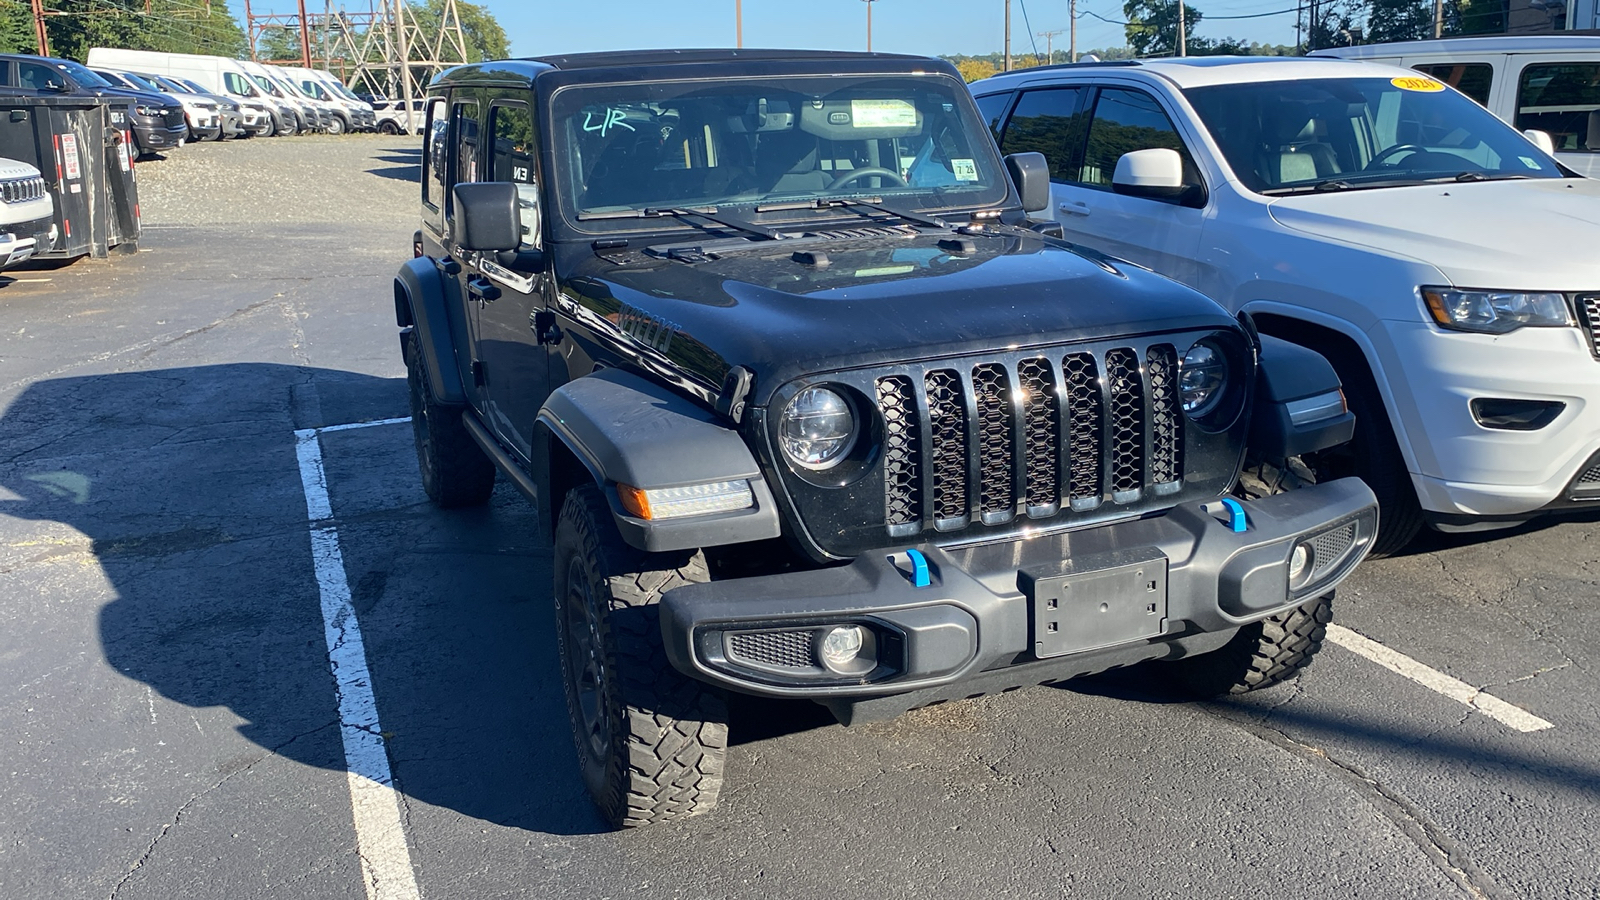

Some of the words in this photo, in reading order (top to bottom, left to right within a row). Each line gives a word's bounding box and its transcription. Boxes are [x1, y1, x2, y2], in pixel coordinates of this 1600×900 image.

[1399, 79, 1435, 88] 2020
[956, 165, 962, 175] 7
[965, 165, 975, 174] 28
